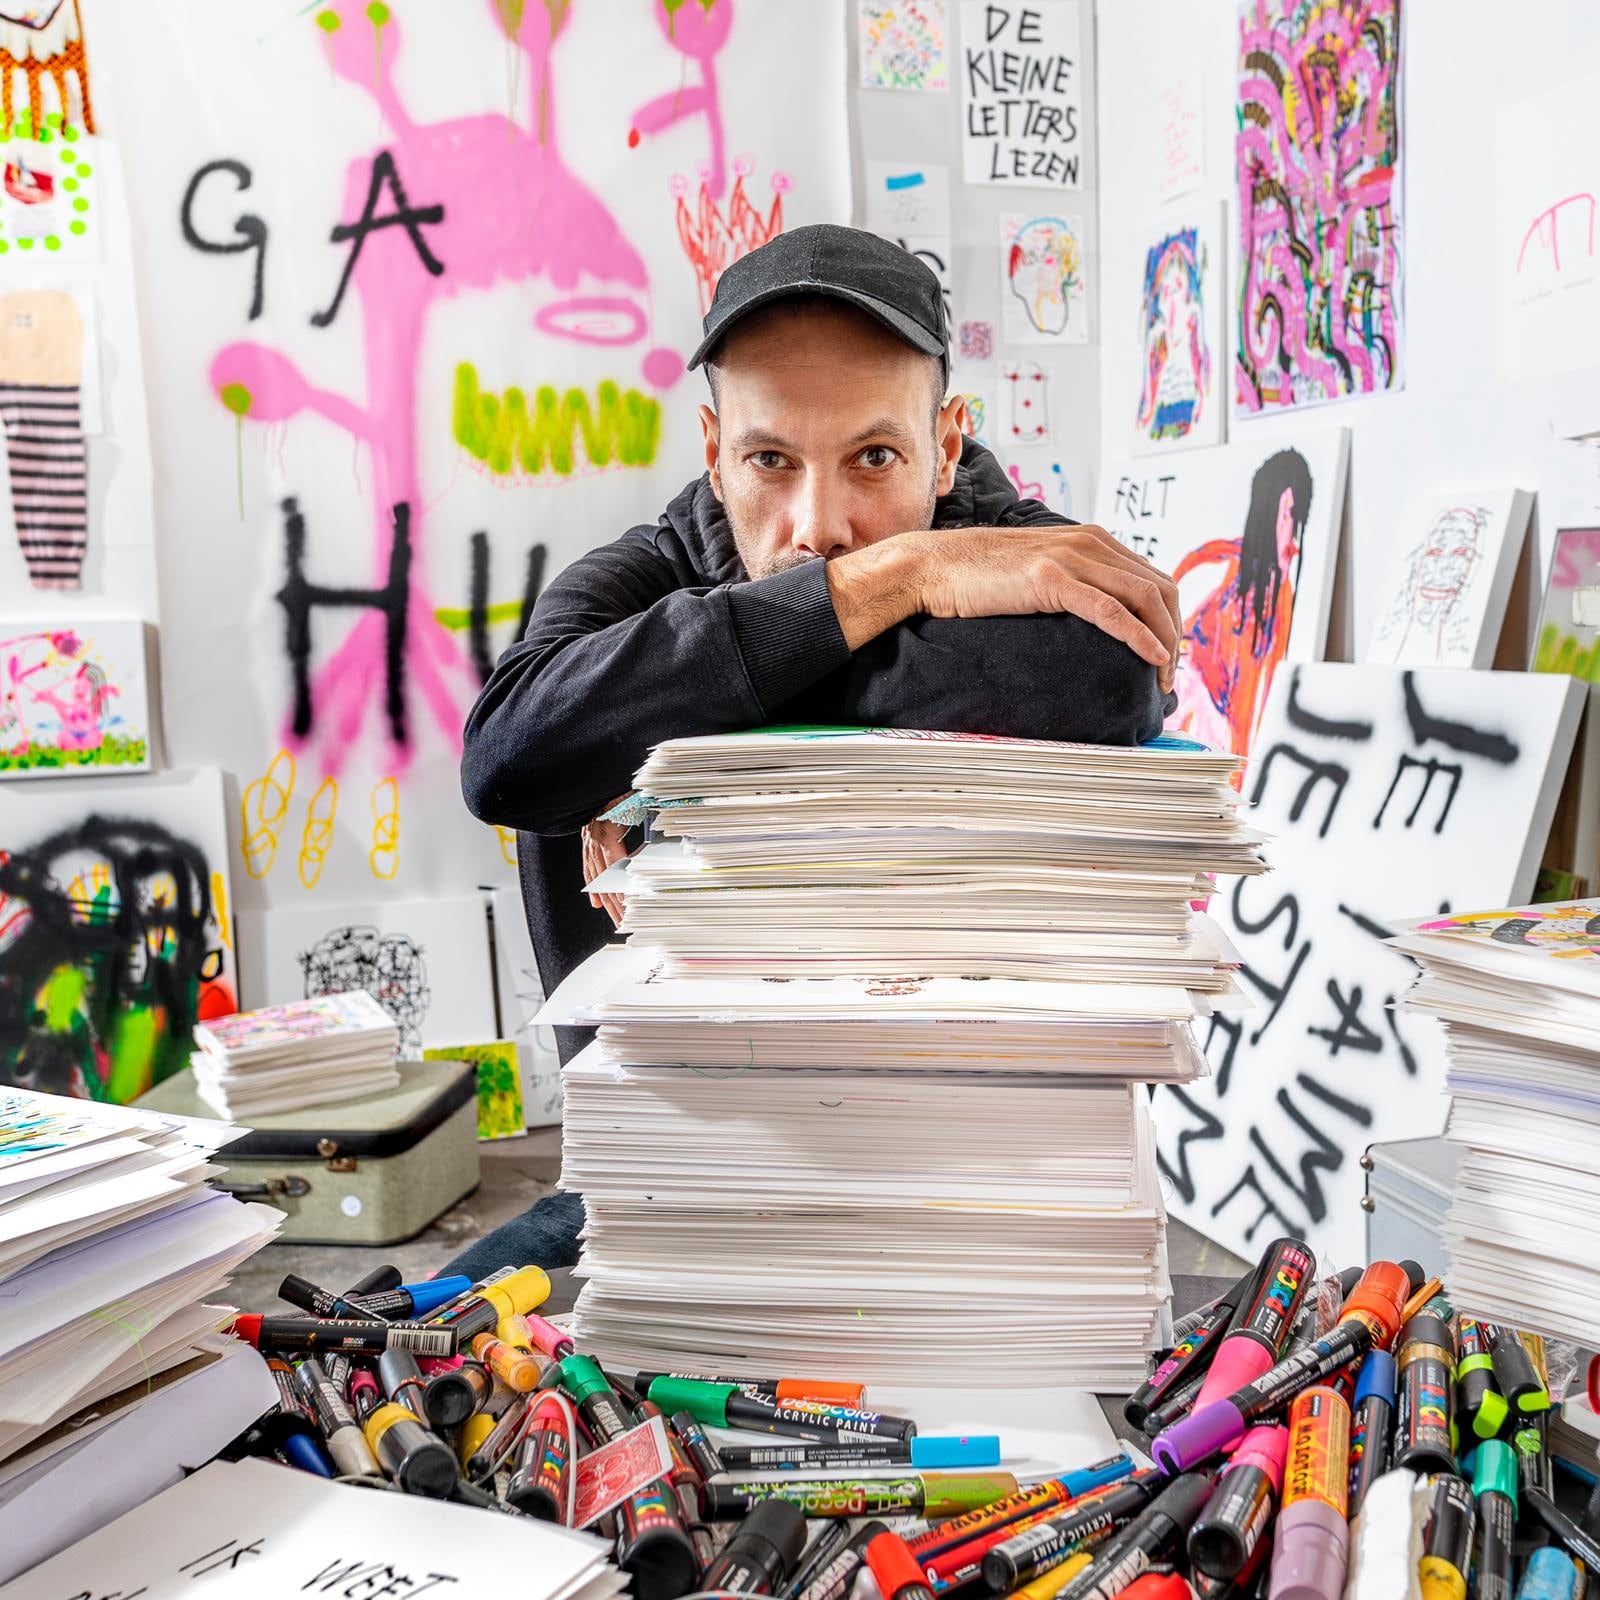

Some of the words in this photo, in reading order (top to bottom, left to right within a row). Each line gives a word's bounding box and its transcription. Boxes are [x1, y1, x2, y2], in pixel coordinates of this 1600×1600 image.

[985, 5, 1043, 43] DE
[966, 48, 1073, 98] KLEINE
[968, 100, 1078, 143] LETTERS
[990, 143, 1079, 185] LEZEN
[1114, 476, 1176, 521] FELT
[1251, 664, 1374, 838] JE
[1372, 670, 1521, 836] JE
[1264, 1265, 1302, 1317] POSCA
[317, 1319, 379, 1329] ACRYLIC
[390, 1321, 429, 1331] PAINT
[1262, 1308, 1281, 1334] uni
[774, 1408, 830, 1427] ACRYLIC
[835, 1418, 877, 1434] PAINT
[951, 1483, 1048, 1531] MOLOTOW
[1063, 1511, 1112, 1541] ACRYLIC
[1032, 1533, 1065, 1562] PAINT
